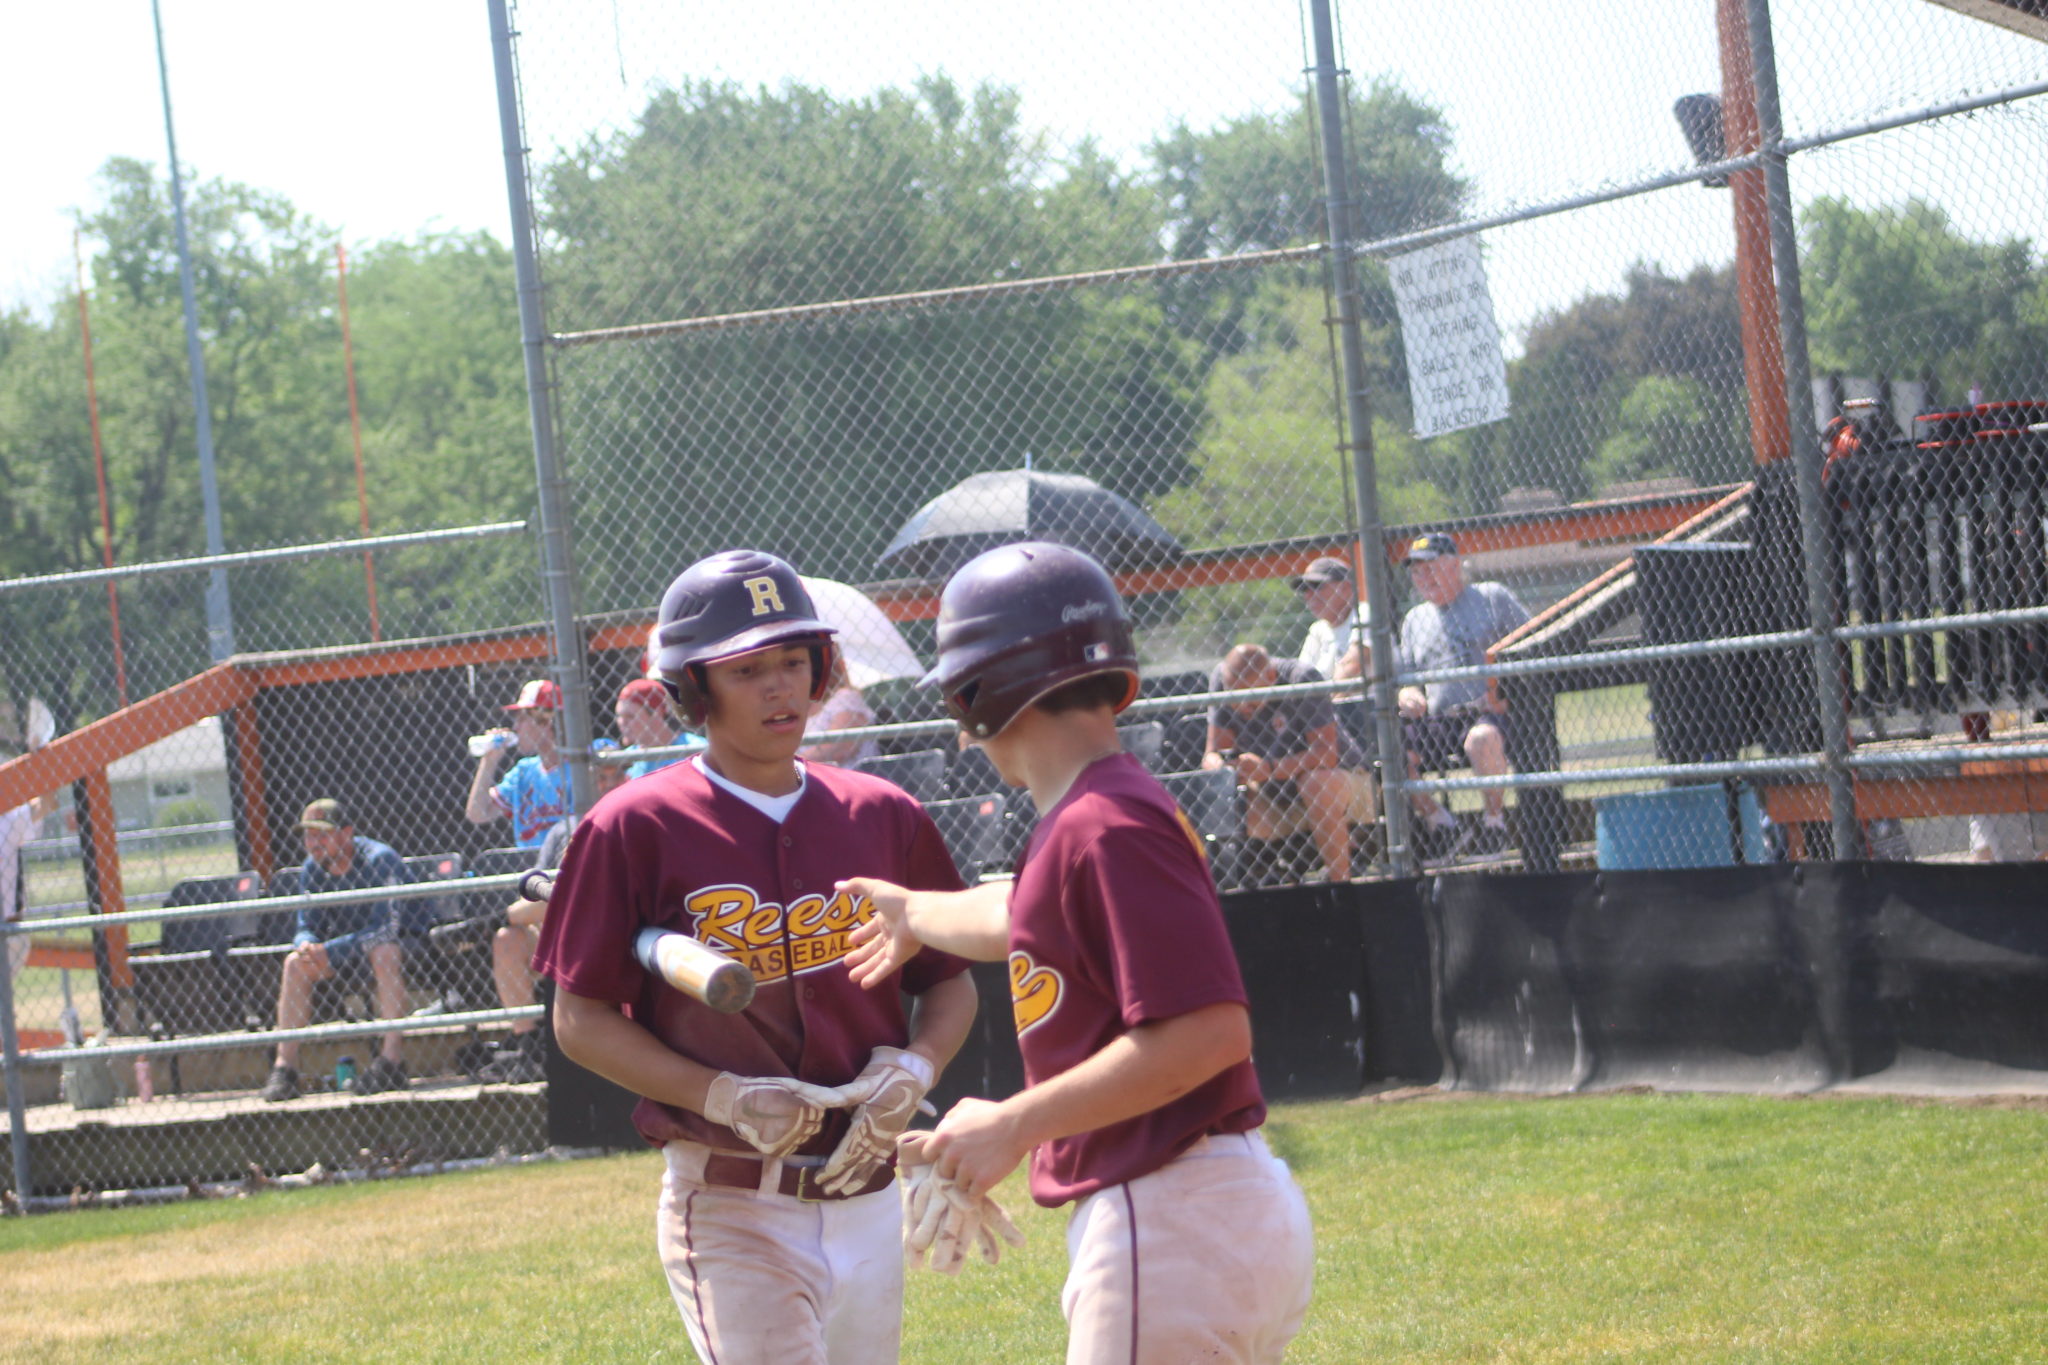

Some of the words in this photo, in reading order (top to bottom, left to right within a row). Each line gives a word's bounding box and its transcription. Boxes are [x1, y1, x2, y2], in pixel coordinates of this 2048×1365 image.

[1399, 268, 1413, 287] NO
[1421, 353, 1457, 376] BALLS
[743, 576, 785, 616] R
[732, 931, 872, 976] ASEBAL
